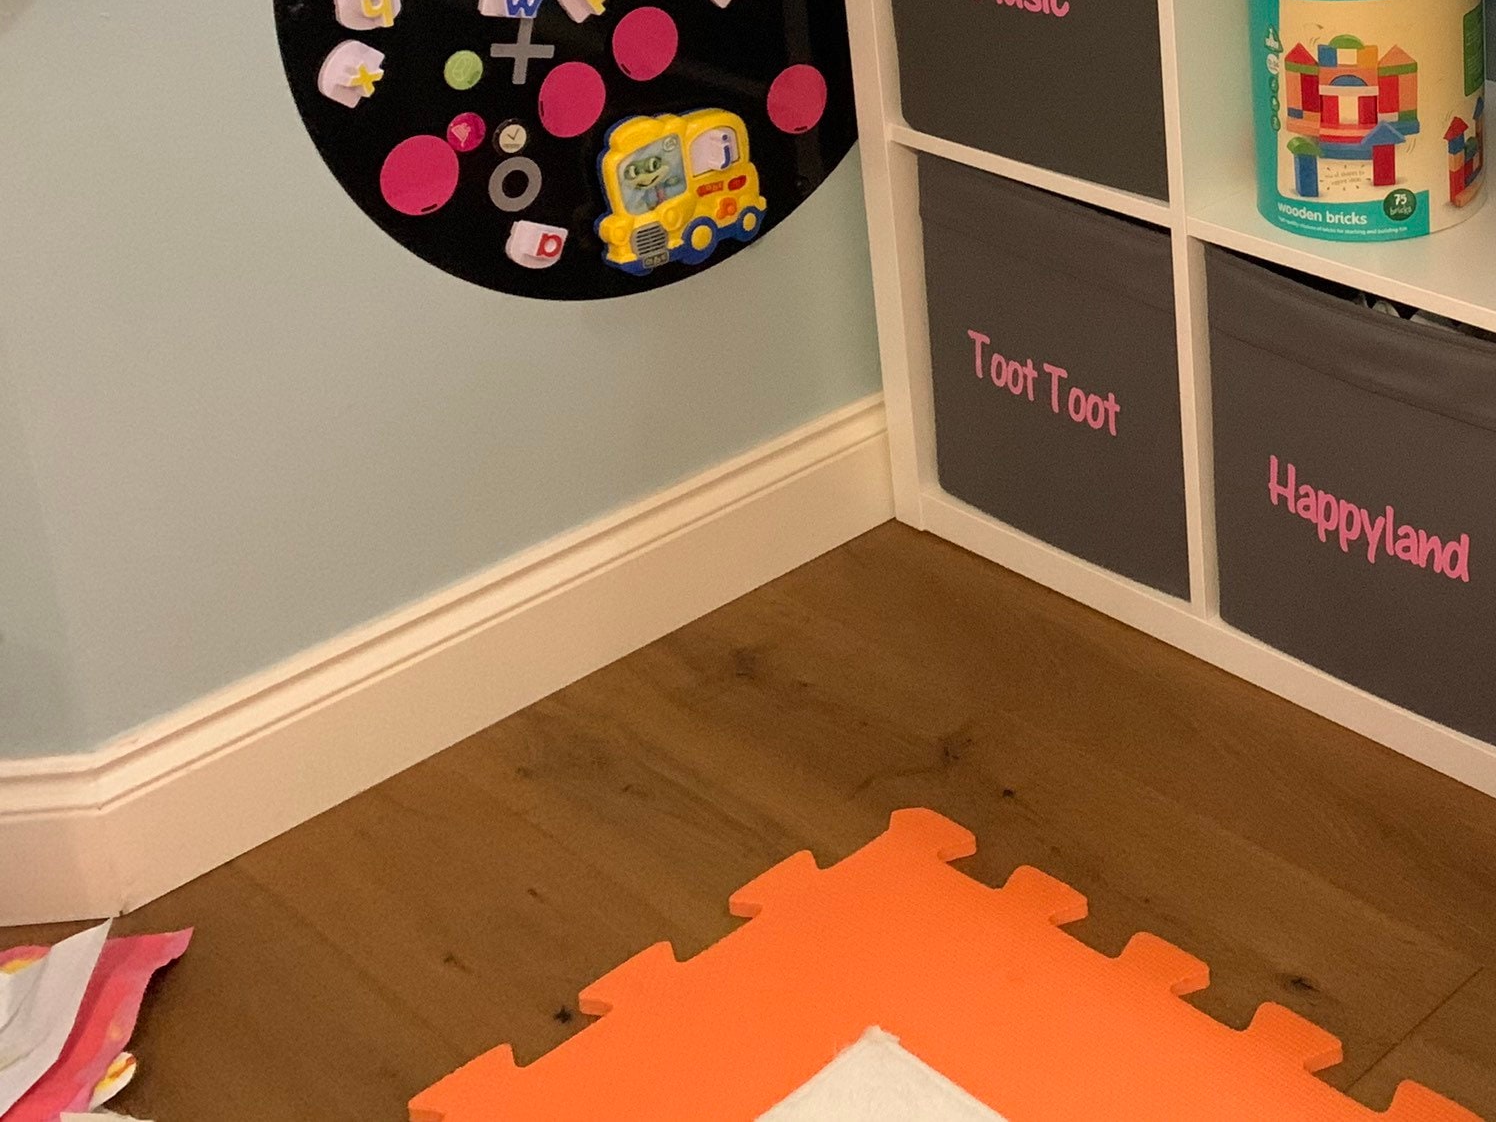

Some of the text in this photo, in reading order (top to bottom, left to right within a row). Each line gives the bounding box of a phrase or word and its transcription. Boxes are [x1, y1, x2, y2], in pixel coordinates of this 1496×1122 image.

[720, 133, 732, 170] j
[1277, 201, 1323, 223] wooden
[1326, 210, 1368, 226] bricks
[1389, 206, 1413, 217] bricks
[1393, 193, 1408, 206] 75
[967, 329, 1121, 437] Toot Toot
[1268, 454, 1470, 583] Happyland
